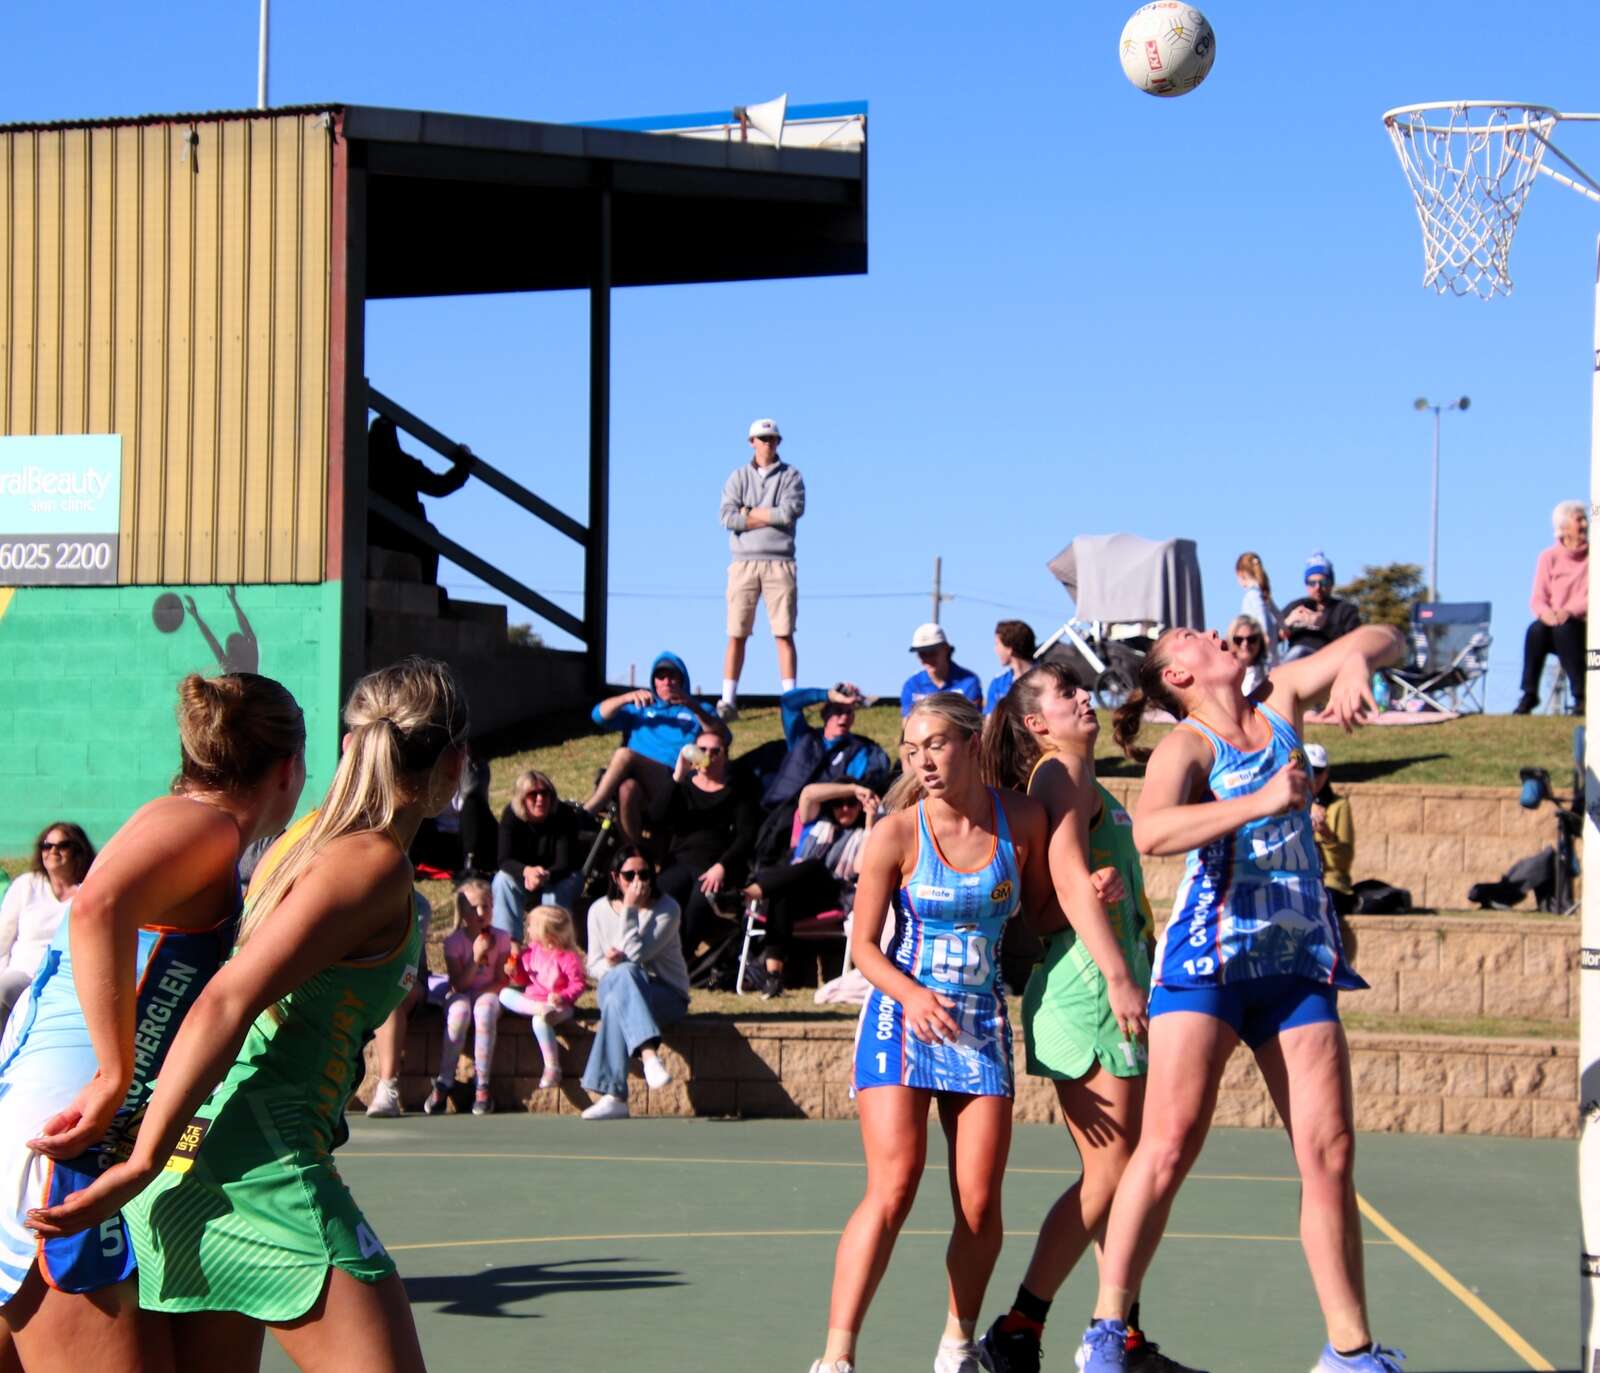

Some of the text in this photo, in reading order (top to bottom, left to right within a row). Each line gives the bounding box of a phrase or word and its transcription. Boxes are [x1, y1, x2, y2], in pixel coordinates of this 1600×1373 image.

[0, 542, 110, 569] 6025 2200
[1253, 818, 1309, 871] GK
[932, 933, 989, 985] GD
[876, 1052, 888, 1074] 1
[98, 1215, 125, 1257] 5
[357, 1221, 384, 1260] 4
